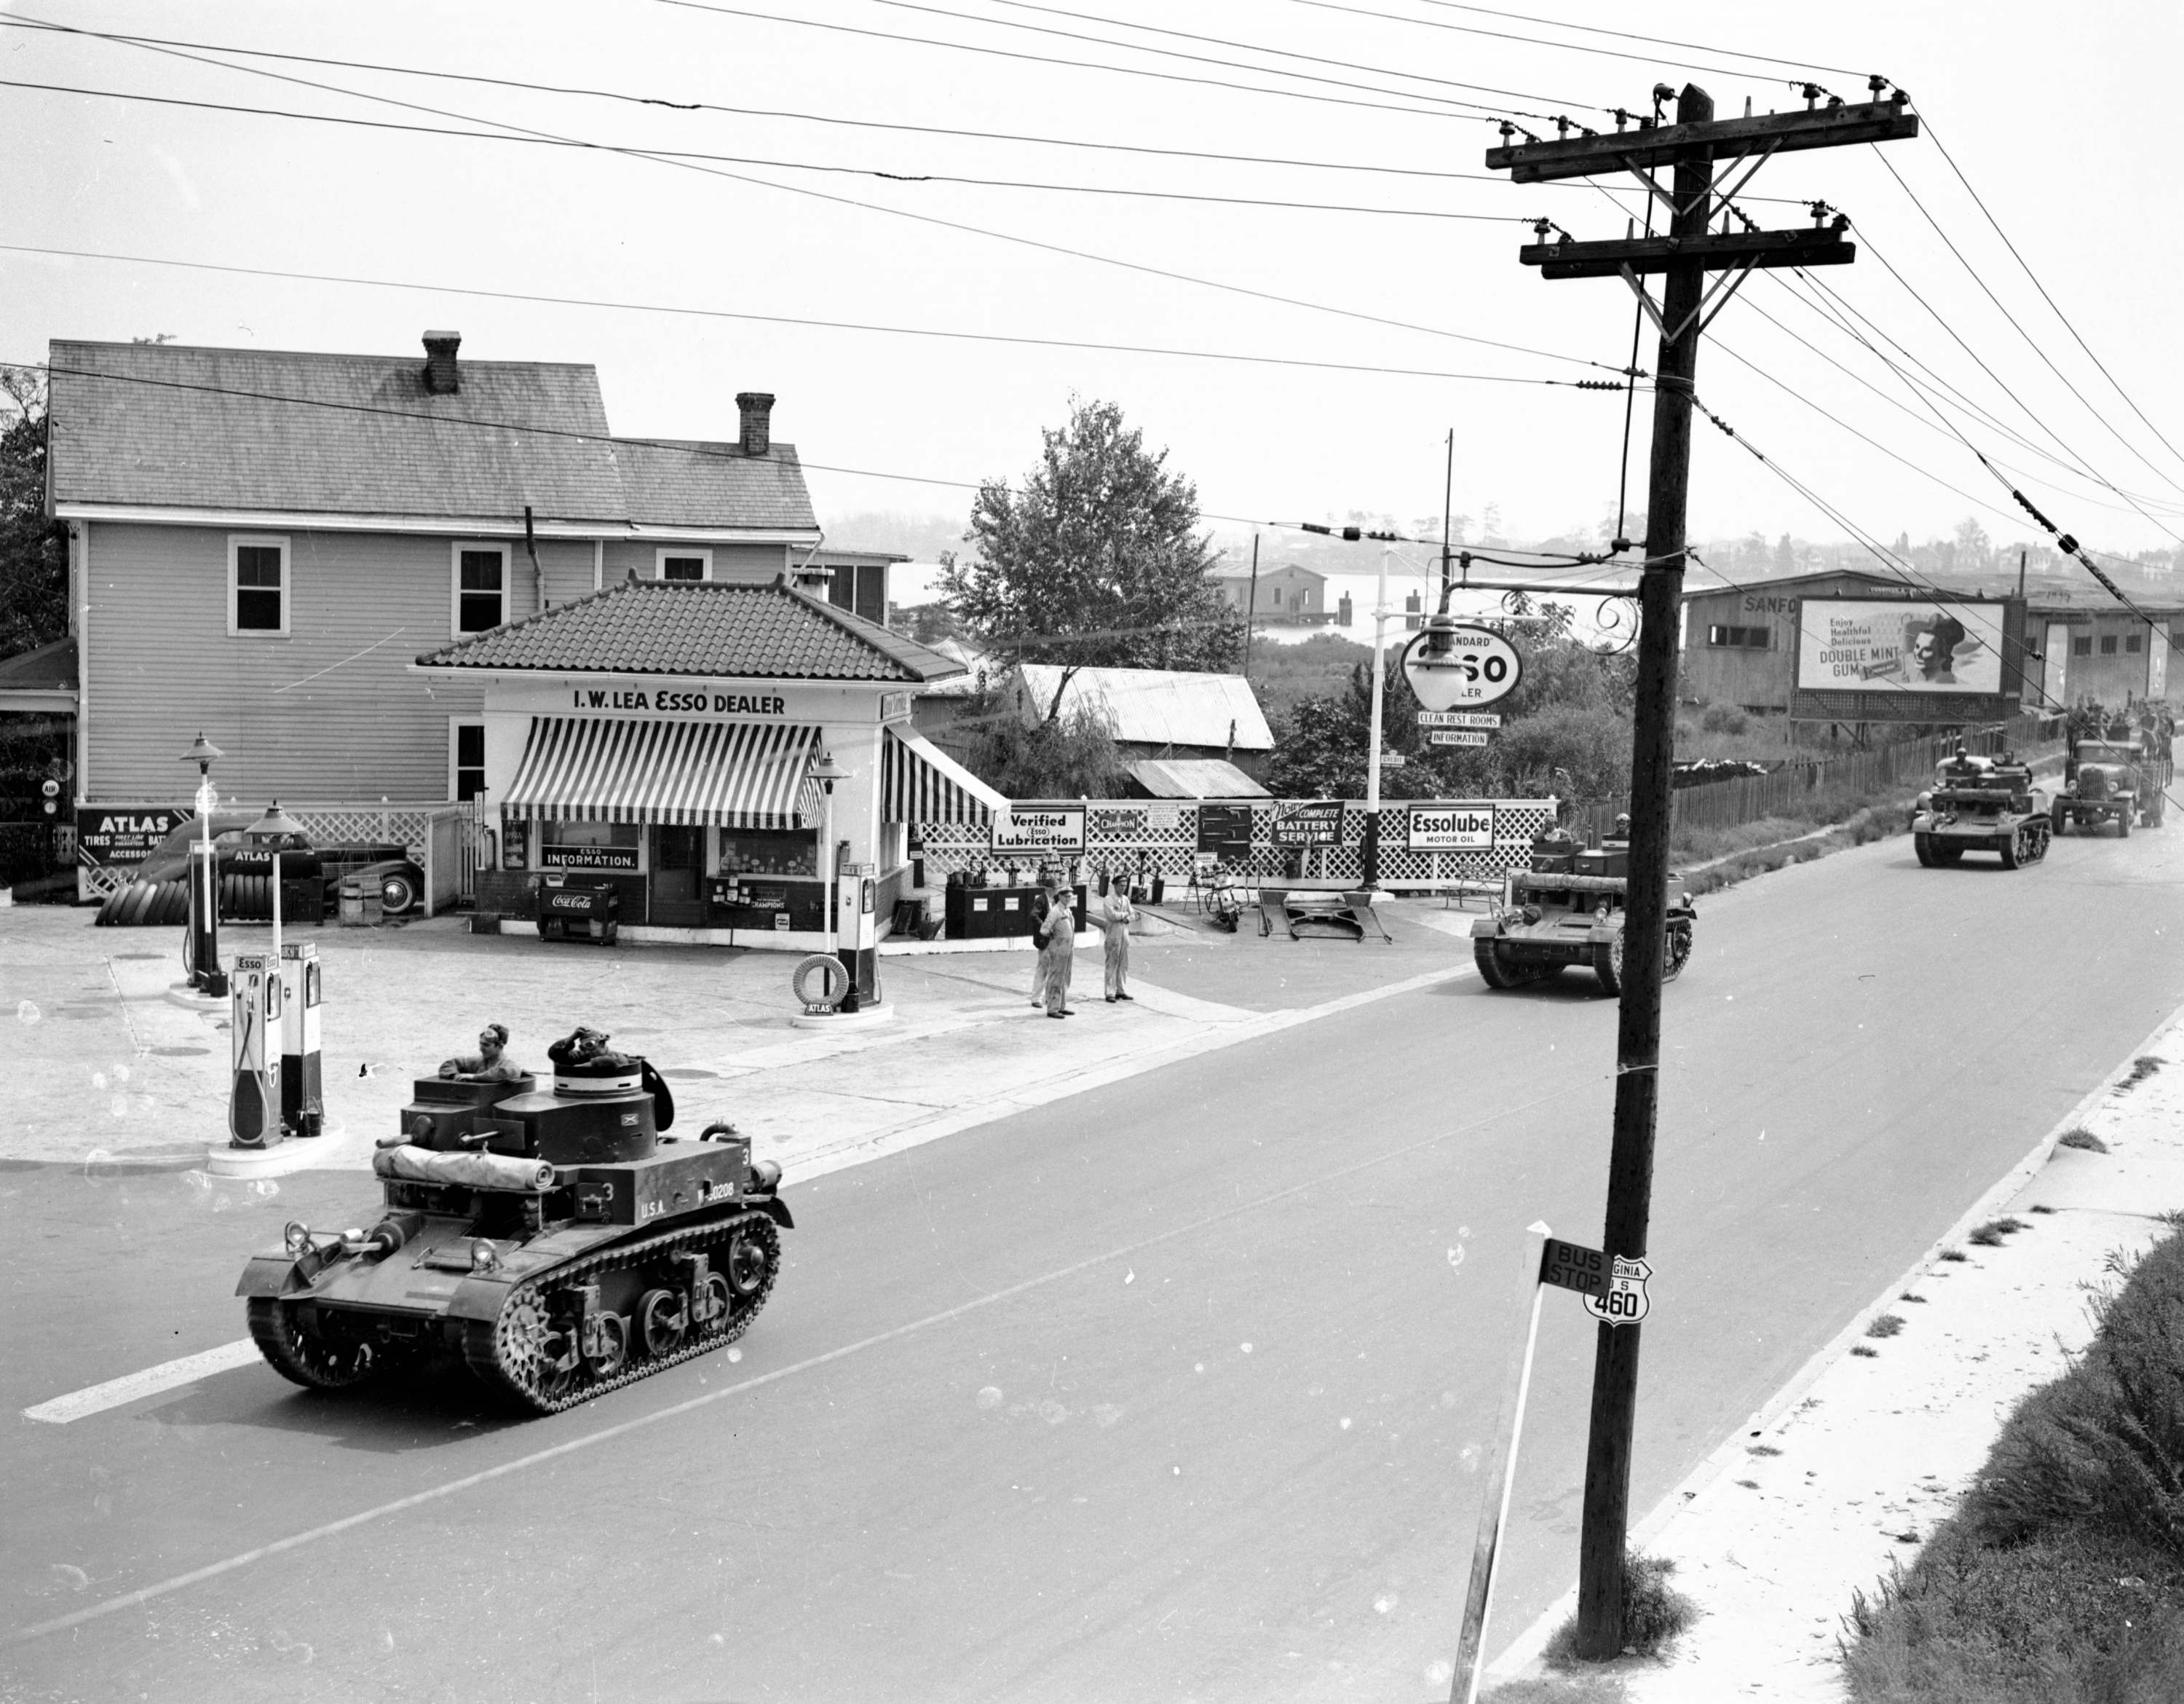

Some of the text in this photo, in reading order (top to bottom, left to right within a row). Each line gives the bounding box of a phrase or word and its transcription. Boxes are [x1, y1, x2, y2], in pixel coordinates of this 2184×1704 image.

[1744, 596, 1796, 613] SANFO
[1830, 618, 1853, 627] Enjoy
[1831, 626, 1871, 636] Healthful
[1831, 638, 1871, 646] Delicious
[1820, 647, 1899, 663] DOUBLE MINT
[1833, 663, 1859, 677] GUM
[1461, 688, 1482, 698] LER
[613, 692, 649, 709] LEA
[714, 695, 785, 714] DEALER
[1420, 713, 1497, 725] CLEAN REST ROOMS
[1433, 733, 1485, 744] INFORMATION
[1299, 808, 1340, 819] COMPLETE
[100, 816, 169, 832] ATLAS
[1010, 814, 1066, 827] Verified
[1101, 818, 1135, 829] CHAMPION
[1276, 820, 1339, 830] BATTERY
[1412, 813, 1490, 832] Essolube
[84, 835, 111, 846] TIRES
[998, 834, 1077, 845] Lubrication
[1278, 832, 1334, 841] SERVICE
[235, 851, 270, 862] ATLAS
[553, 894, 593, 909] Coca-Cola
[808, 1004, 831, 1012] ATLAS
[742, 1148, 749, 1165] 3
[602, 1183, 614, 1201] 3
[1558, 1245, 1602, 1271] BUS
[1613, 1263, 1640, 1277] GINIA
[1550, 1263, 1602, 1291] STOP
[1621, 1281, 1629, 1290] S
[1594, 1291, 1637, 1317] 460
